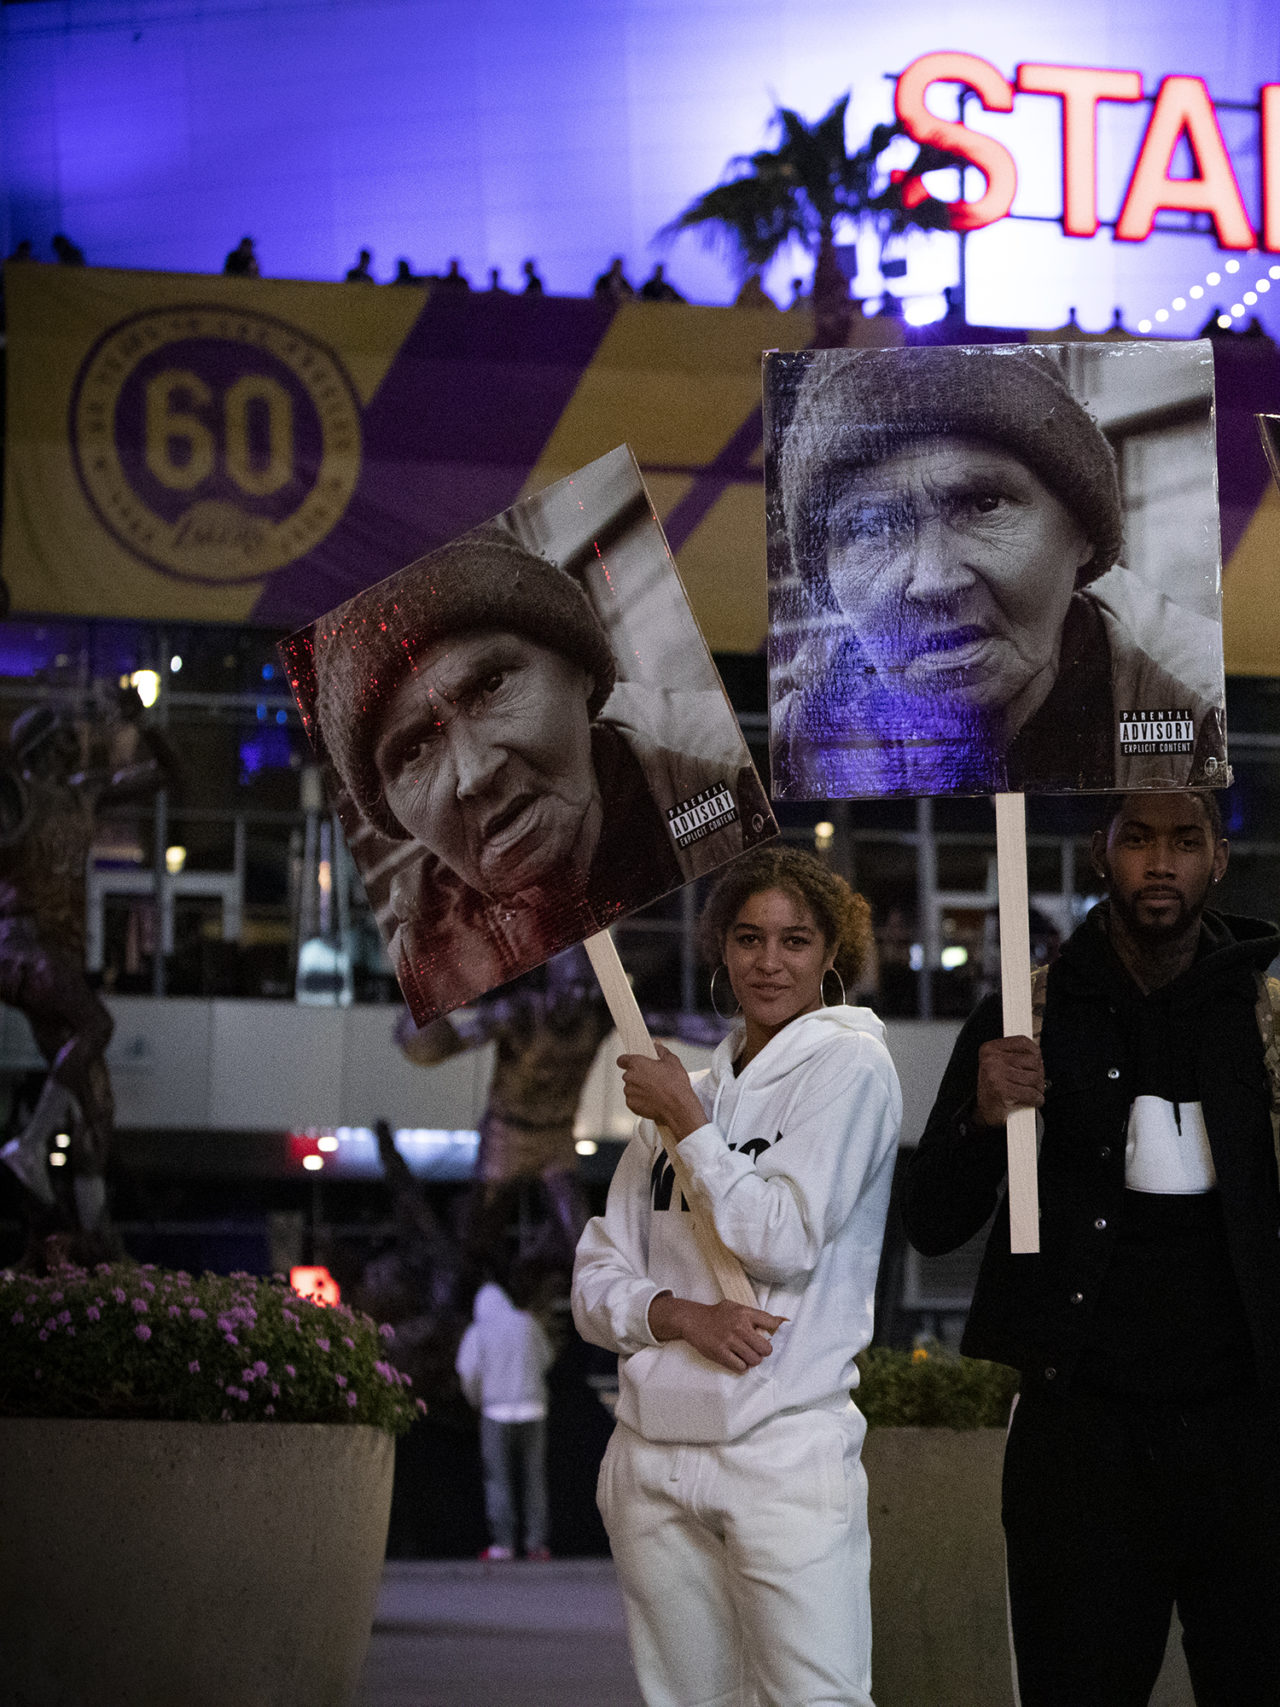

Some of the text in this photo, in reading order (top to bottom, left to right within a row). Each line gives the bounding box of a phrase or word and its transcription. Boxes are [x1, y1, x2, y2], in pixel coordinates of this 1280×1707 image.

[145, 367, 294, 497] 60
[1122, 722, 1191, 741] ADVISORY
[1123, 710, 1189, 721] PARENTAL
[1124, 742, 1190, 753] EXPLICIT CONTENT
[668, 782, 725, 819] PARENTAL
[672, 792, 732, 837] ADVISORY
[679, 811, 736, 847] EXPLICIT CONTENT
